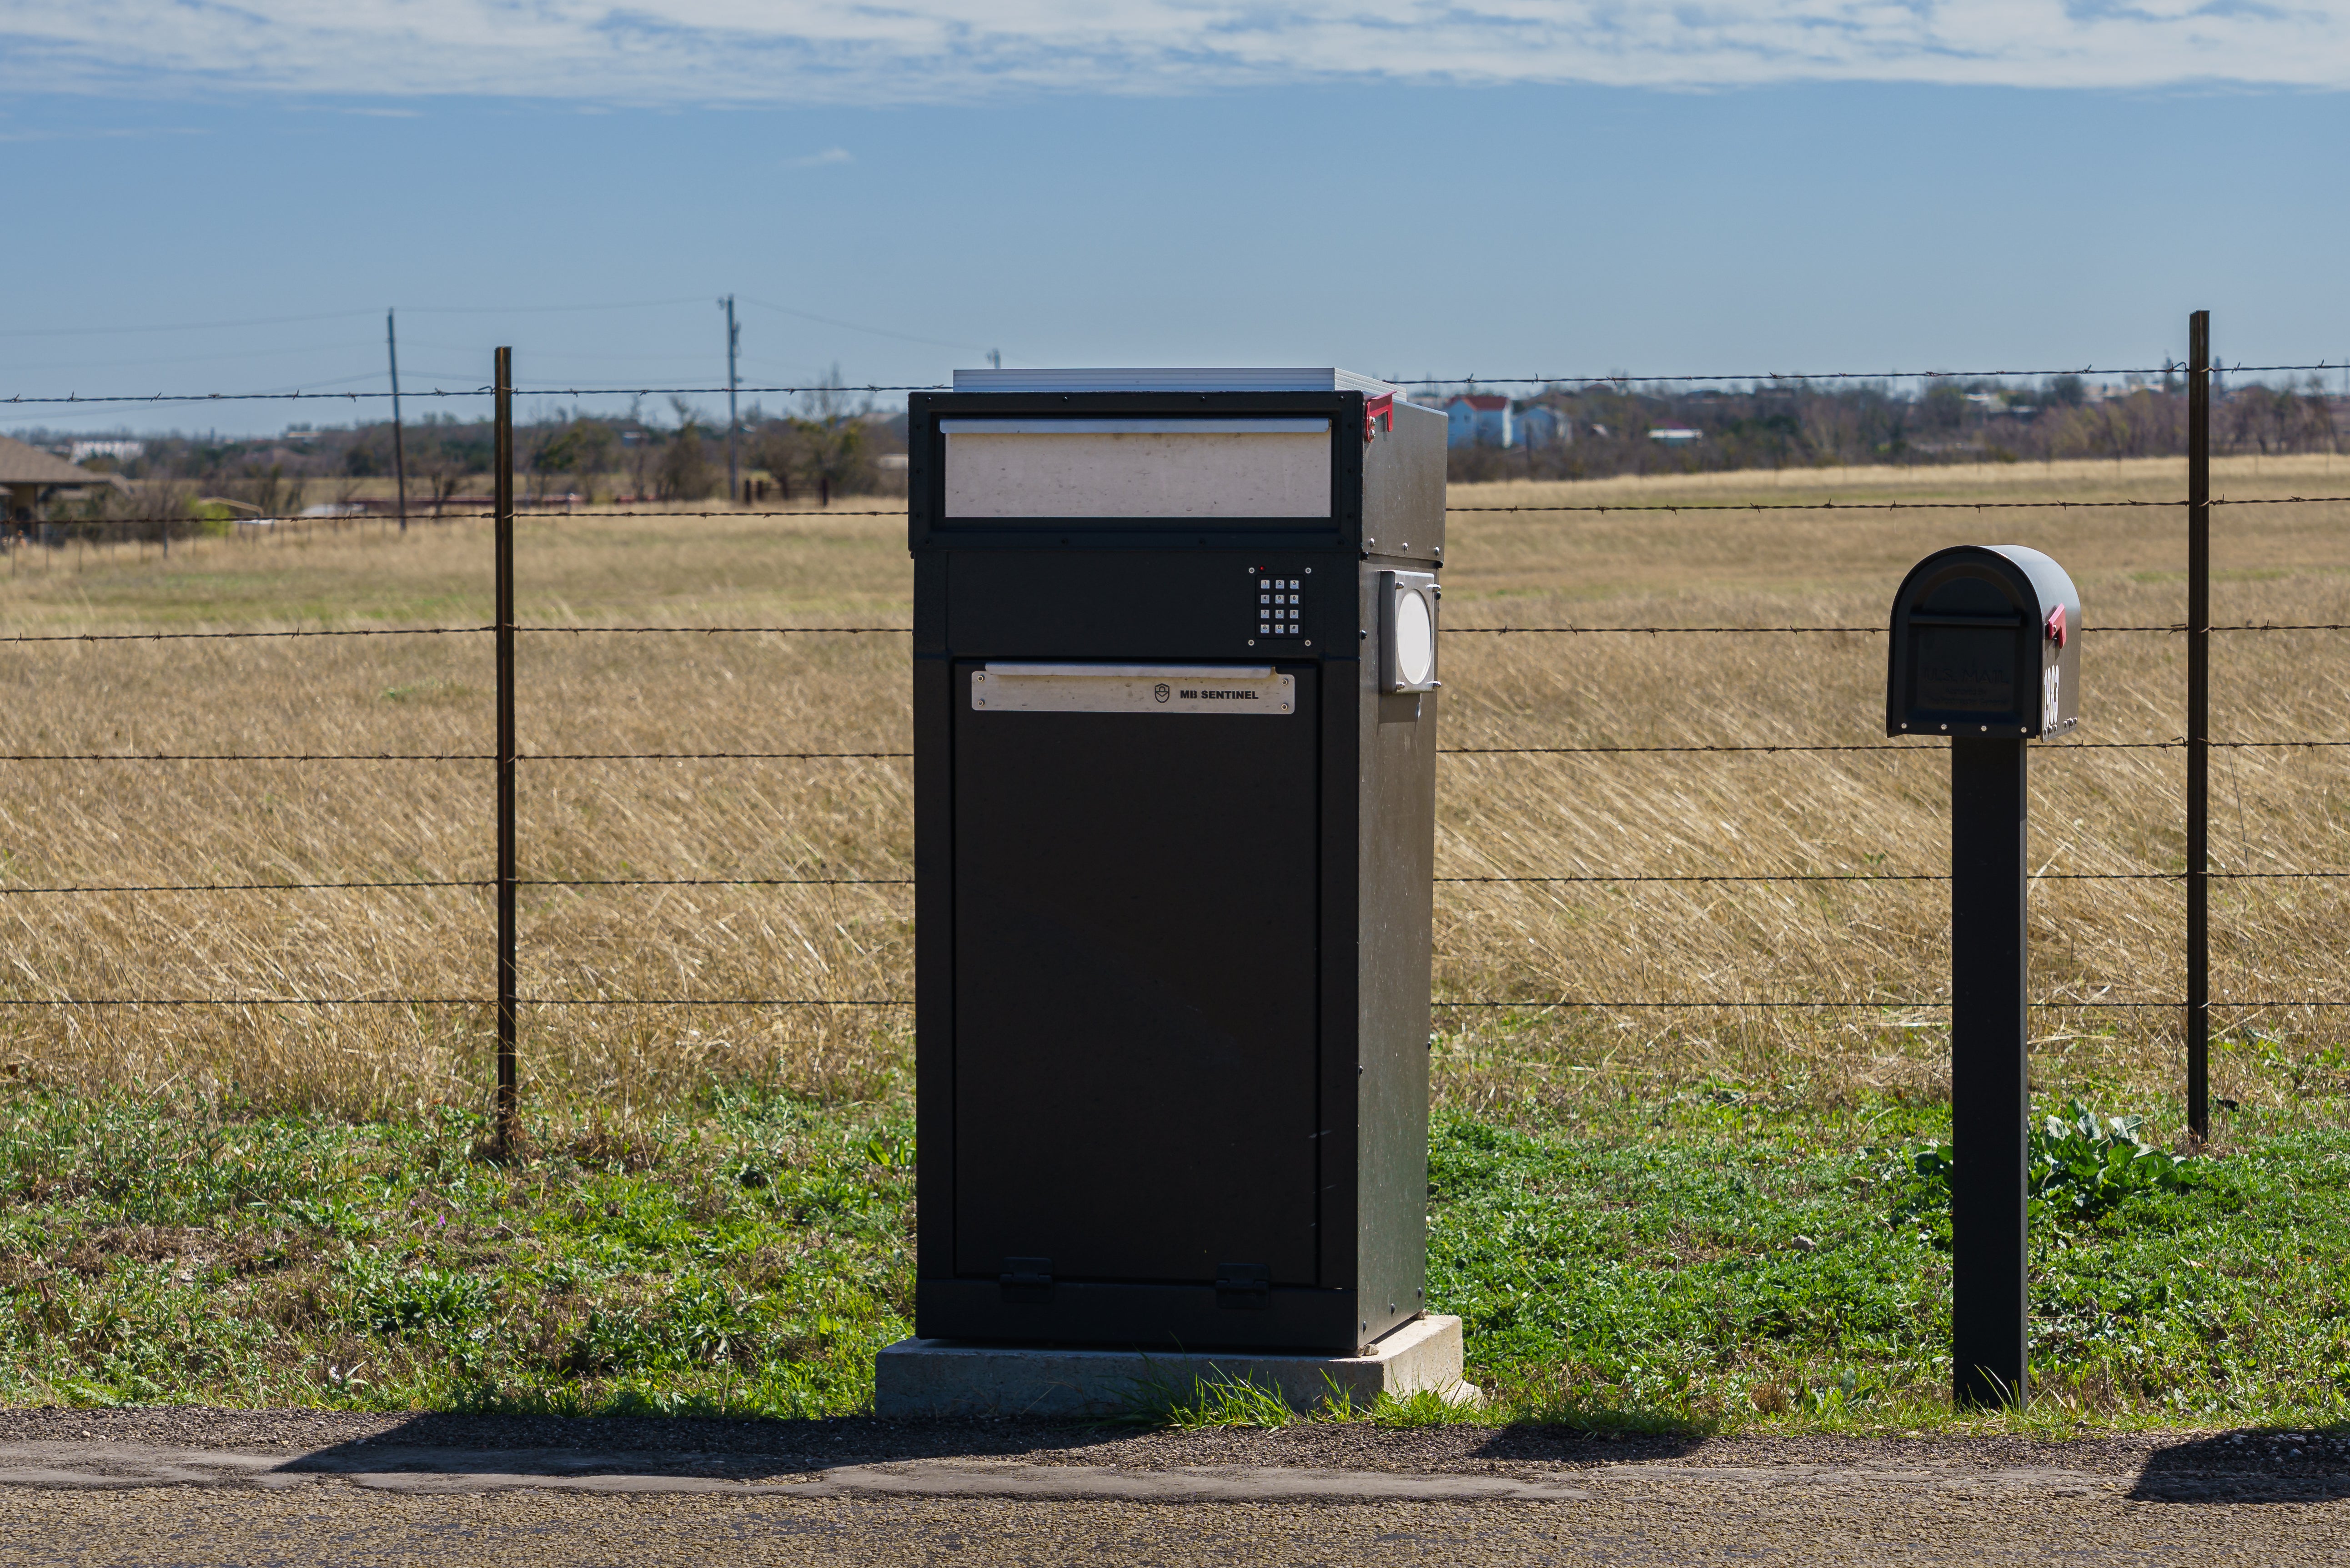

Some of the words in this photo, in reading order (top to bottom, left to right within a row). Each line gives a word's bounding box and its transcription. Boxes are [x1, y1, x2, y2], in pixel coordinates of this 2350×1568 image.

[1962, 668, 2009, 684] MAIL
[1180, 690, 1198, 699] MB
[1201, 690, 1259, 699] SENTINEL
[2044, 664, 2059, 729] 1983
